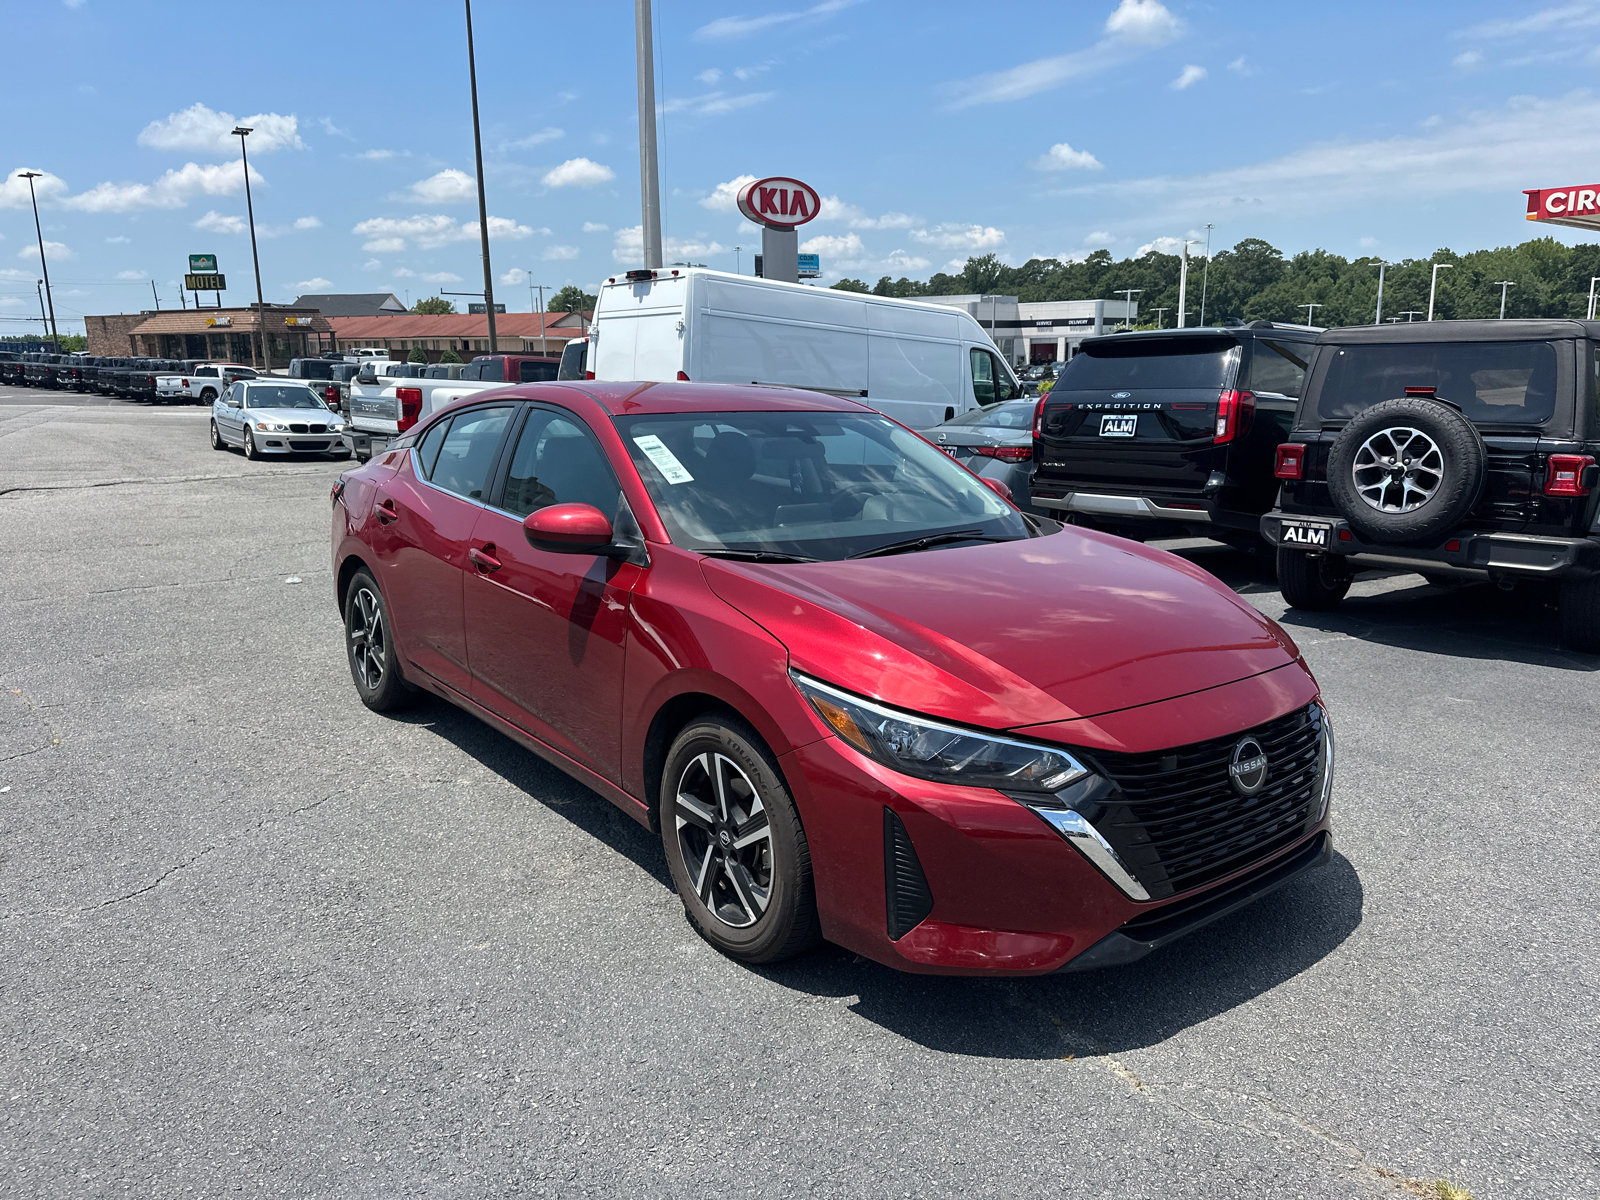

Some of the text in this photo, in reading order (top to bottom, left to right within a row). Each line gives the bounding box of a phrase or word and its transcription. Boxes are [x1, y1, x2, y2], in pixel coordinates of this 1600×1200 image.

[758, 187, 809, 216] KIA
[1545, 189, 1600, 213] CIR
[186, 275, 223, 289] MOTEL
[1104, 420, 1133, 432] ALM
[1283, 526, 1325, 545] ALM
[726, 736, 769, 796] TOURING
[1231, 756, 1266, 775] NISSAN
